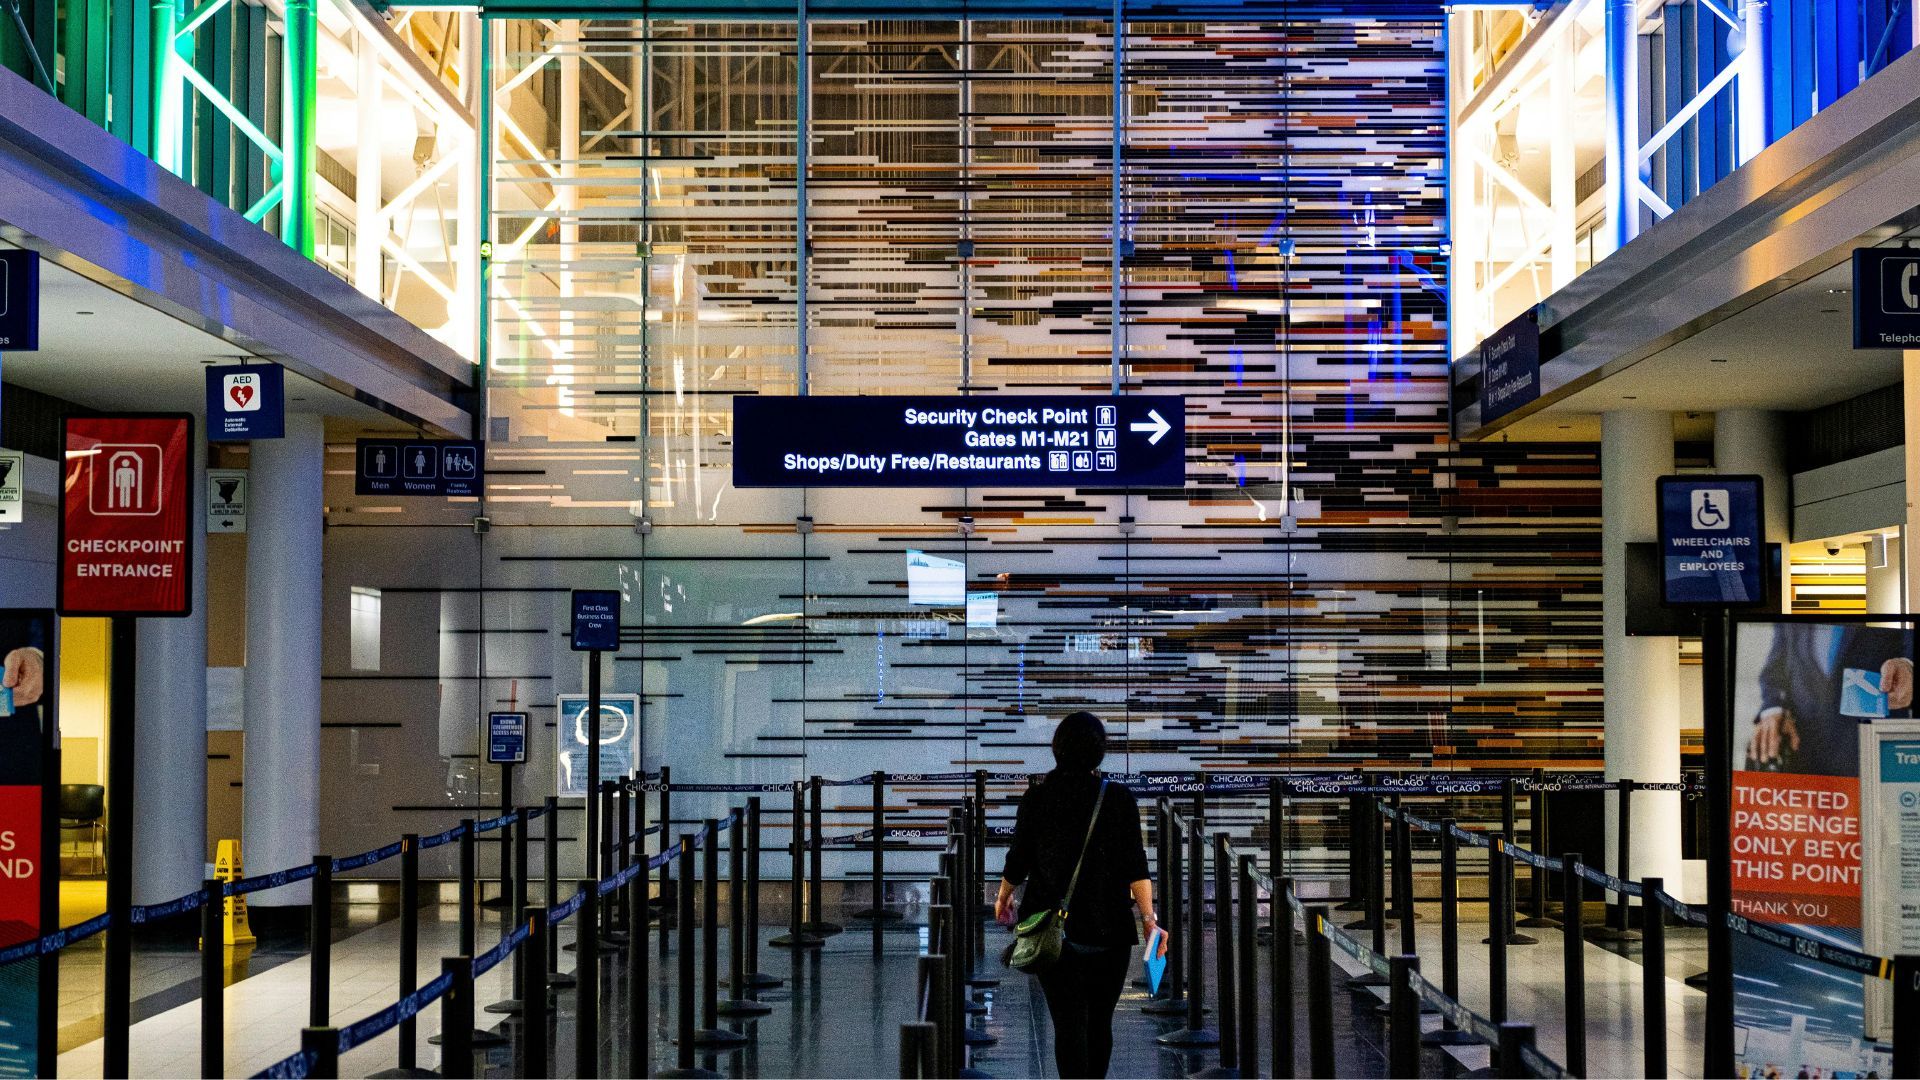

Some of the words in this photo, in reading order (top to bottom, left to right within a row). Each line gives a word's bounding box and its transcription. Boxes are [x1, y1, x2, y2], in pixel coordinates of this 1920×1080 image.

[1880, 333, 1920, 344] Telepho
[233, 376, 251, 384] AED
[905, 408, 977, 427] Security
[981, 408, 1038, 424] Check
[1042, 408, 1087, 424] Point
[964, 431, 1017, 447] Gates
[1021, 431, 1089, 446] M1-M21
[1098, 431, 1114, 446] M
[784, 453, 886, 473] Shops/Duty
[891, 453, 1041, 470] Free/Restaurants
[404, 482, 436, 490] Women
[67, 539, 184, 553] CHECKPOINT
[1672, 537, 1751, 546] WHEELCHAIRS
[1700, 550, 1724, 559] AND
[77, 564, 173, 577] ENTRANCE
[1680, 562, 1745, 571] EMPLOYEES
[1896, 752, 1920, 764] Tra
[1148, 776, 1178, 784] CHICAGO
[1383, 779, 1424, 787] CHICAGO
[625, 784, 669, 792] CHICAGO
[761, 784, 795, 792] CHICA
[1169, 783, 1205, 792] CHICAGO
[1296, 785, 1340, 793] CHICAGO
[1436, 784, 1480, 793] CHICAGO
[1523, 783, 1561, 791] CHICAGO
[1643, 783, 1686, 791] CHICAGO
[1735, 786, 1849, 810] TICKETED
[1734, 811, 1858, 835] PASSENGE
[891, 829, 920, 837] CHICAGO
[1733, 835, 1797, 855] ONLY
[1732, 859, 1784, 880] THIS
[1792, 863, 1862, 884] POINT
[1732, 900, 1788, 915] THANK
[1793, 903, 1828, 918] YOU
